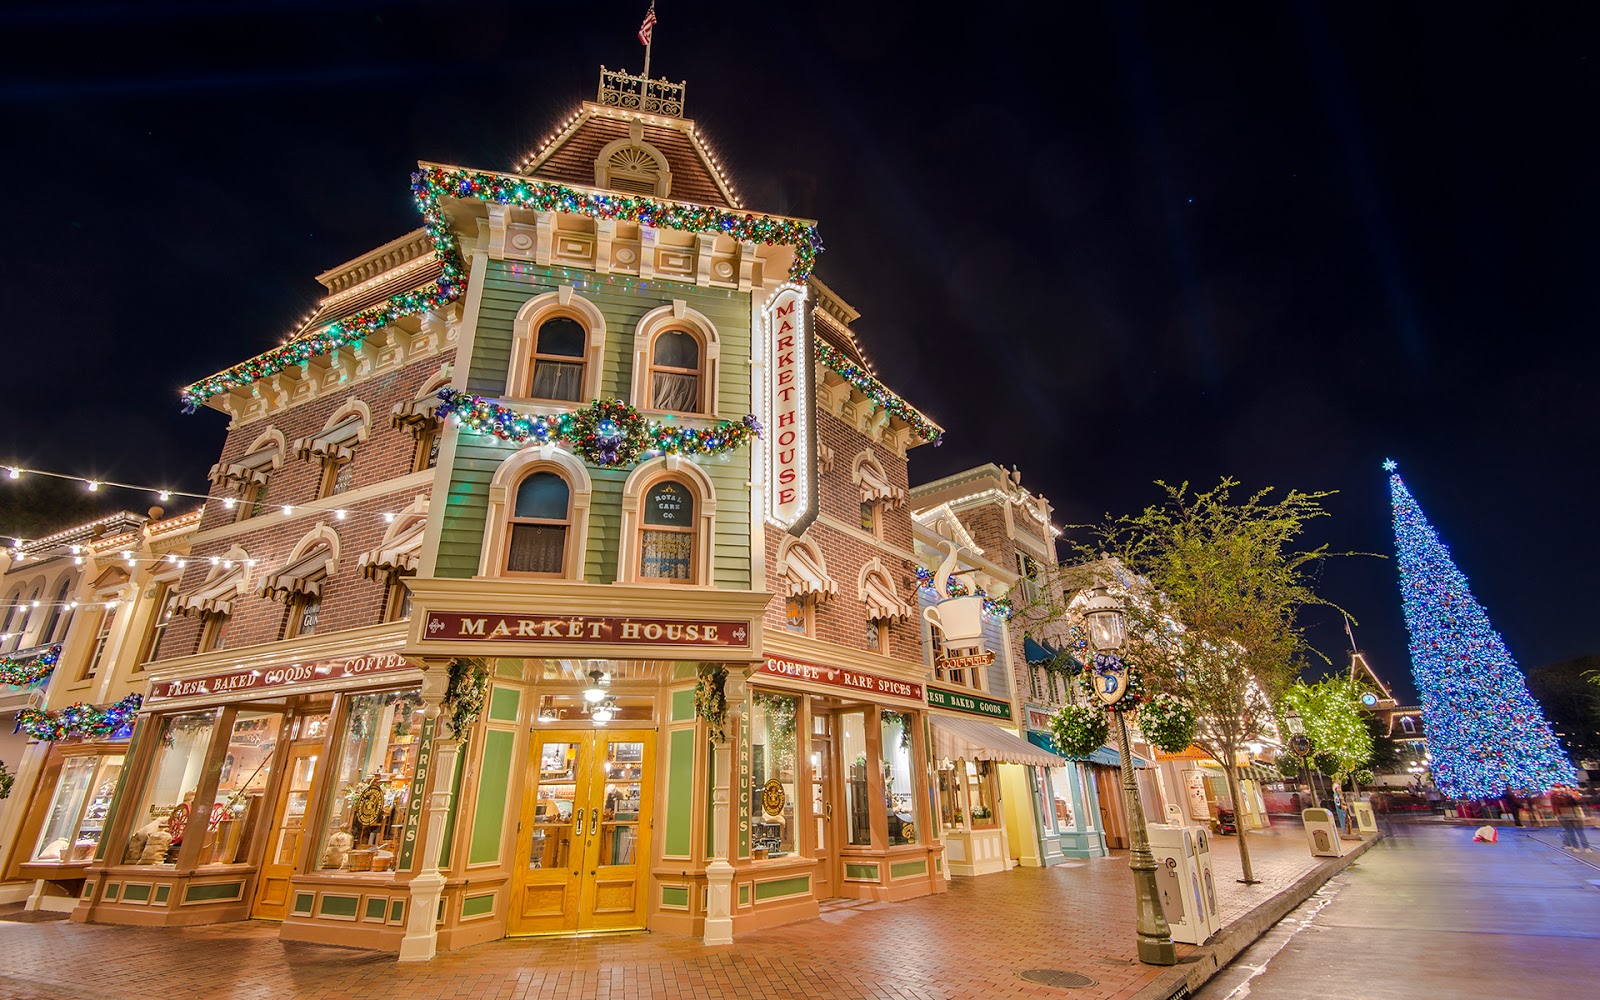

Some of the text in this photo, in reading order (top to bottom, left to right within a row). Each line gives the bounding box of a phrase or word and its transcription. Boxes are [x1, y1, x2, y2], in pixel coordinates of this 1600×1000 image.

[775, 300, 796, 505] MARKET HOUSE
[655, 494, 682, 503] ROYAL
[459, 617, 719, 641] MARKET HOUSE
[167, 654, 407, 697] FRESH BAKED GOODS COFFEE
[767, 658, 911, 696] COFFEE RARE SPICES
[941, 655, 990, 669] COFFEE
[951, 695, 975, 709] BAKED
[979, 701, 1002, 714] GOODS
[405, 718, 434, 842] TARBUCKS
[739, 711, 749, 832] STARBUCKS
